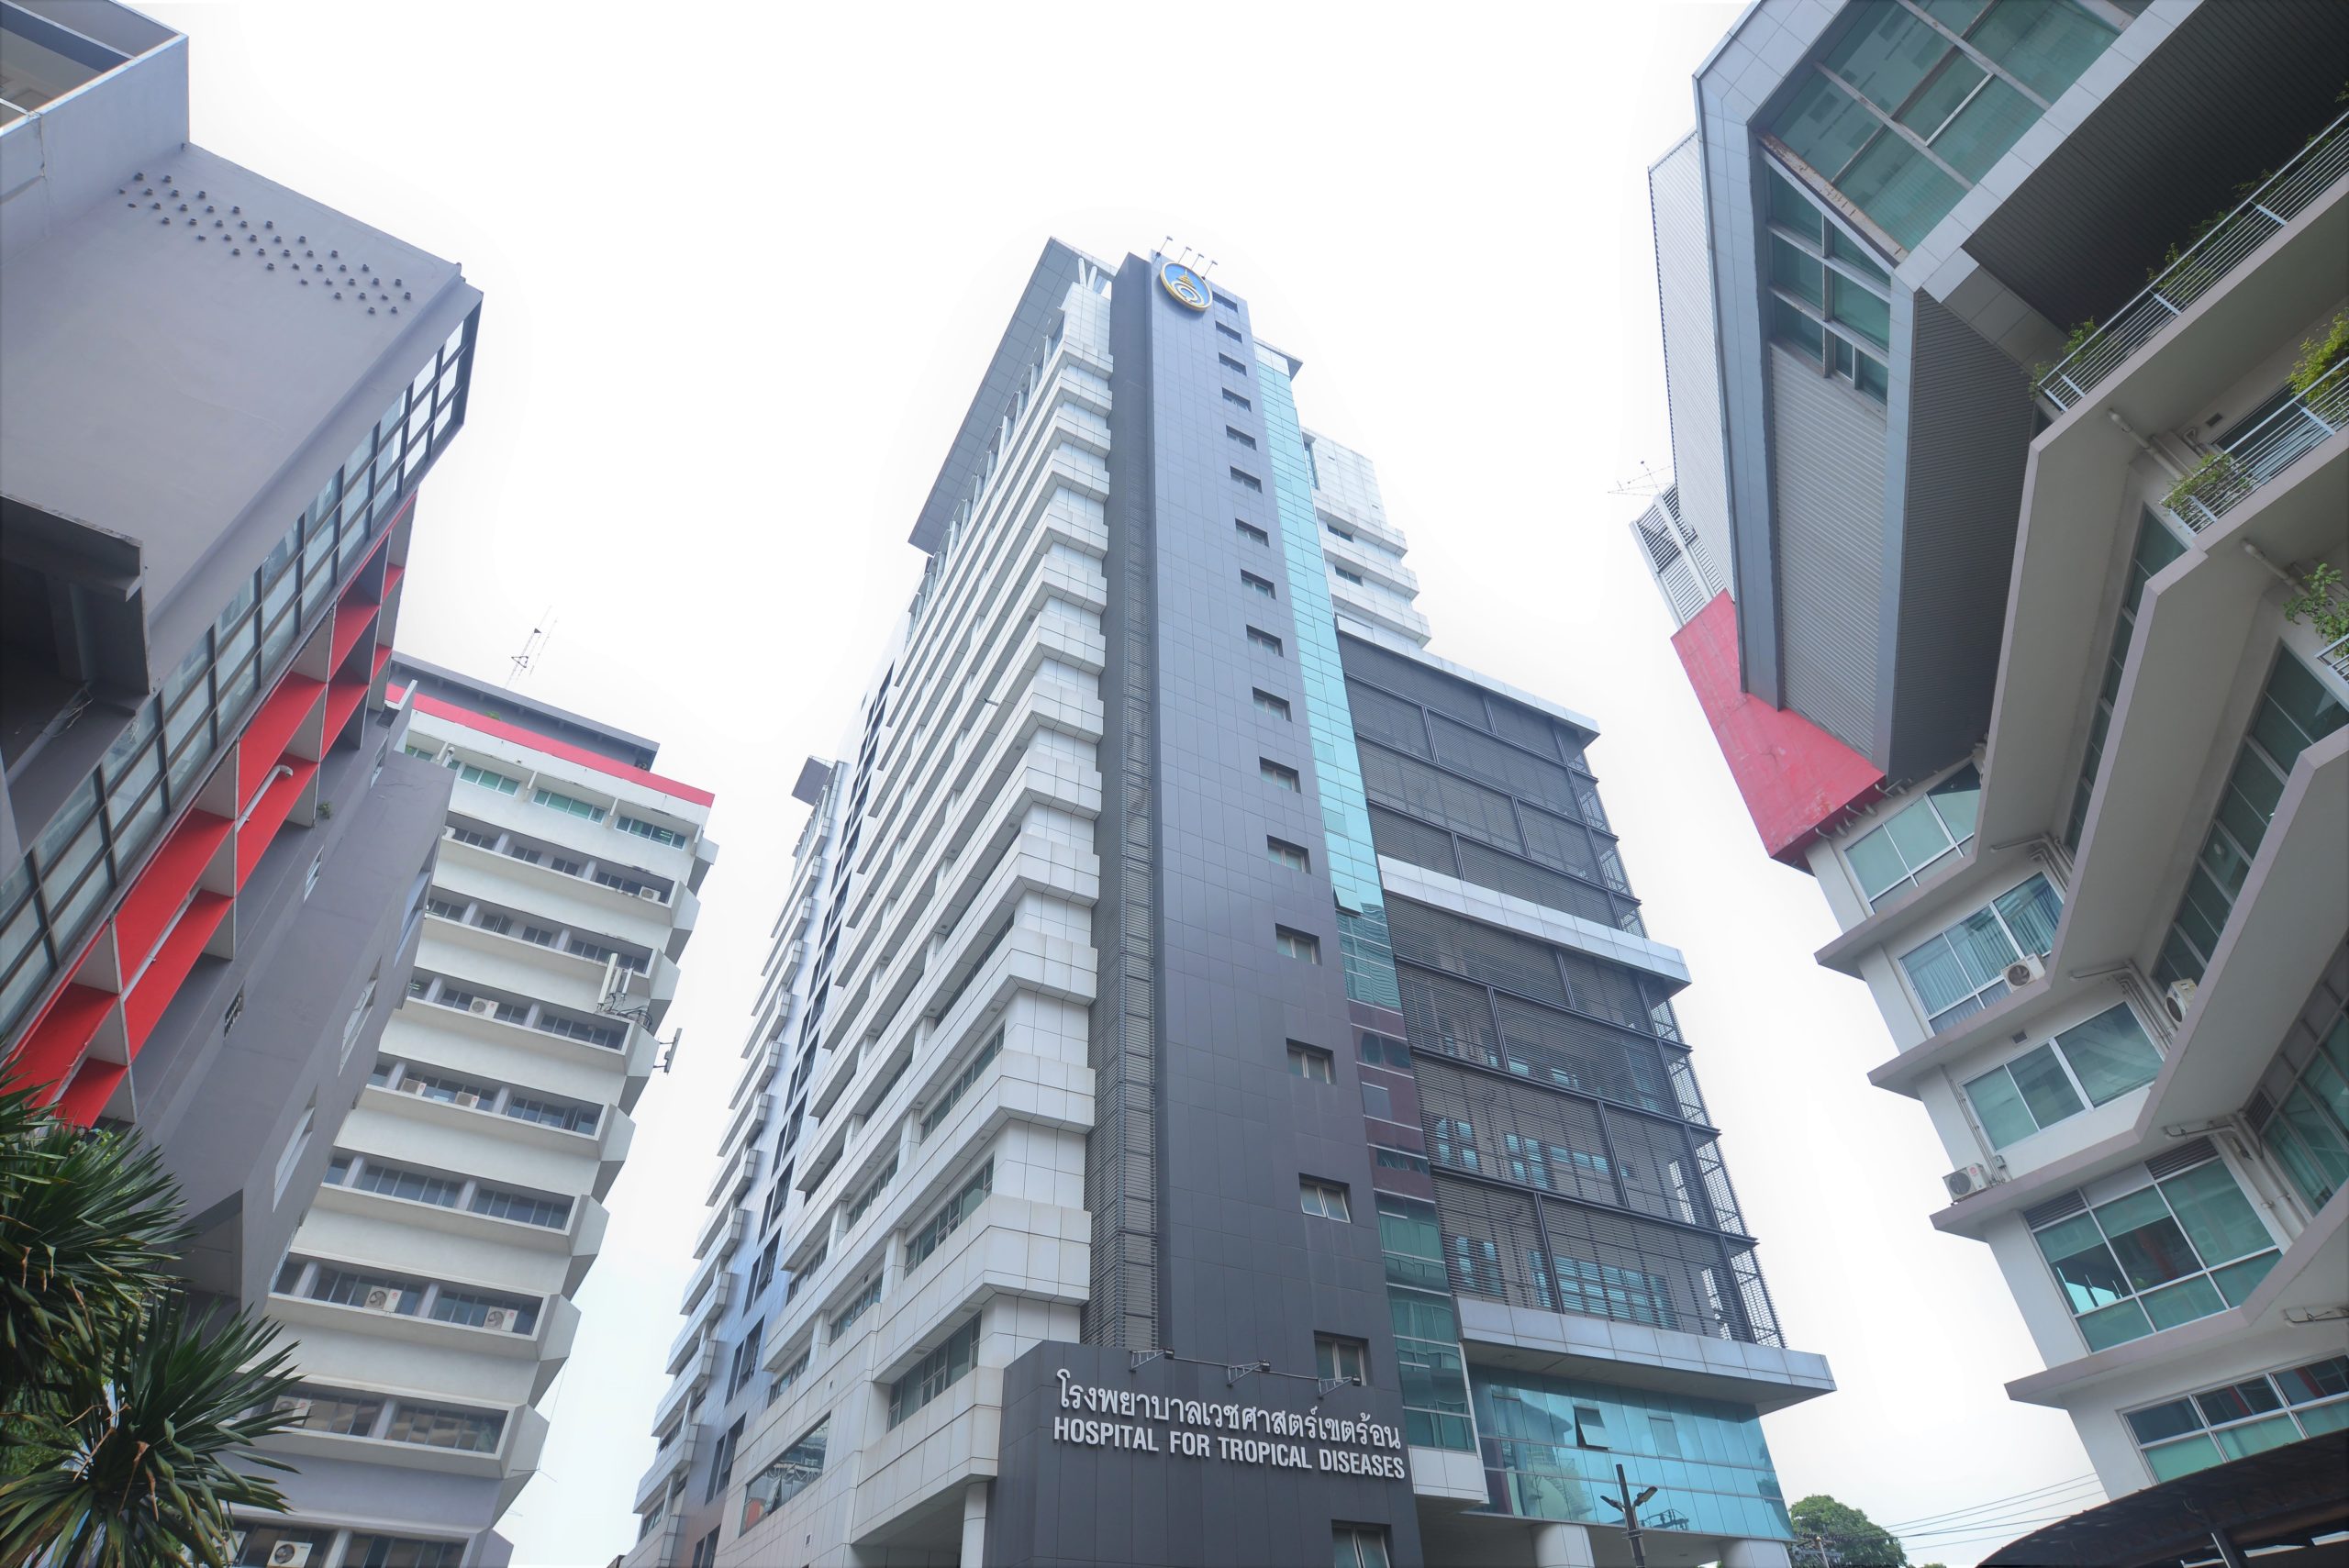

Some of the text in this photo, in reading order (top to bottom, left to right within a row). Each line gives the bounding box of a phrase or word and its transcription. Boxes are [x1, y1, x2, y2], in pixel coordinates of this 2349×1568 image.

[1057, 1368, 1401, 1450] โรงพยาบาลเวชศาสตร์เขตร้อน
[1054, 1416, 1406, 1479] HOSPITAL FOR TROPICAL DISEASES
